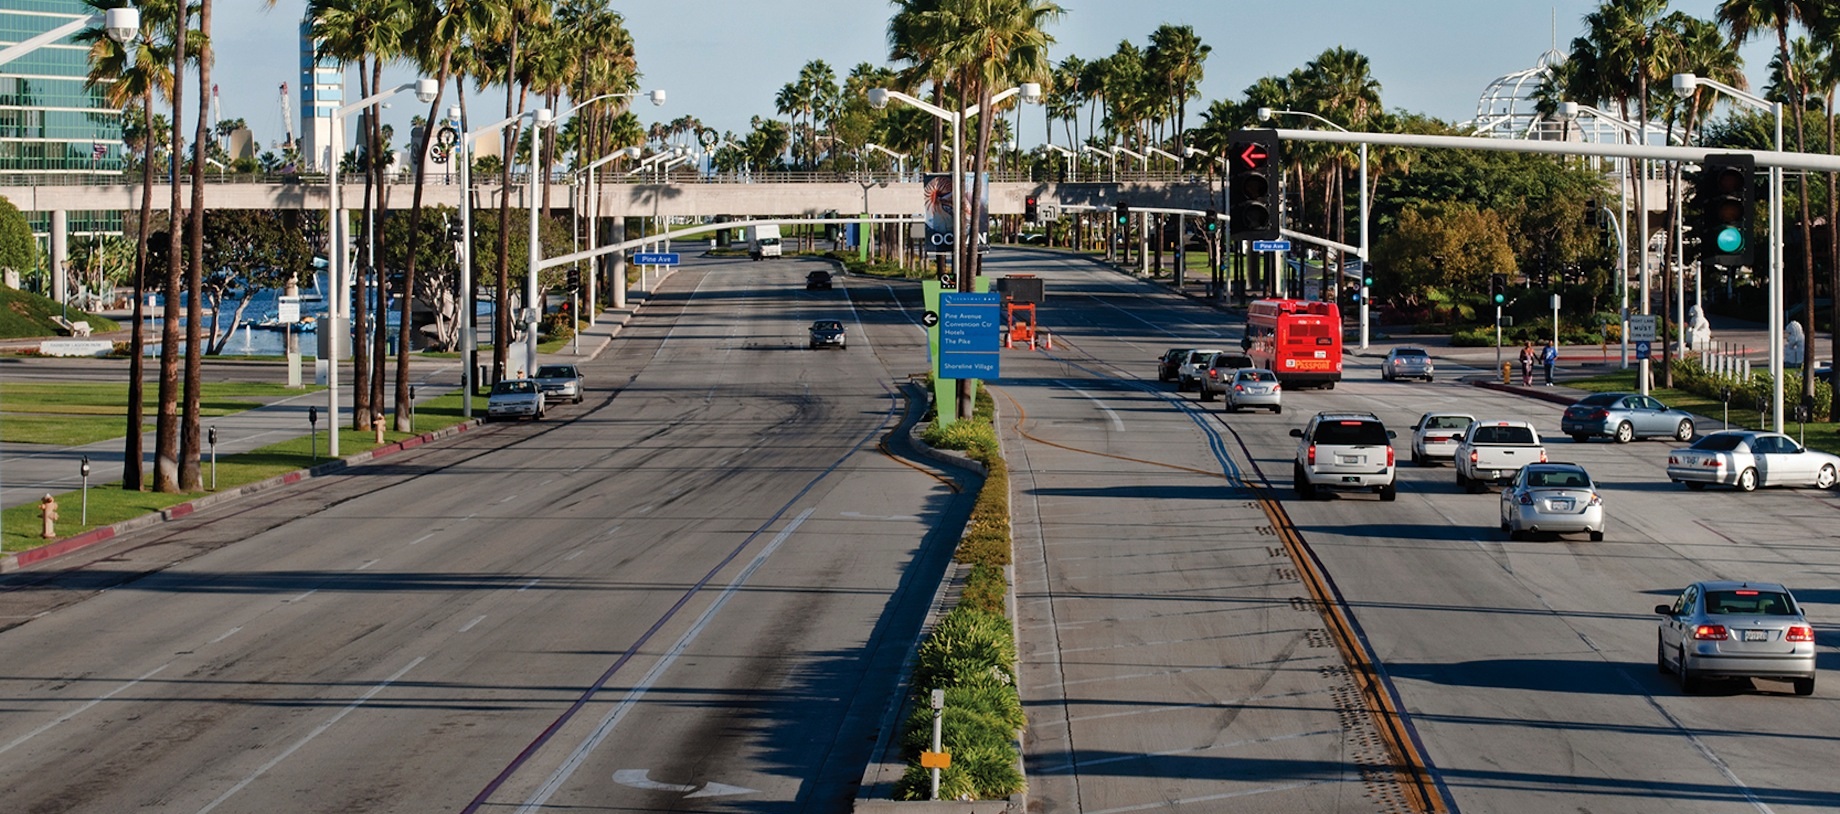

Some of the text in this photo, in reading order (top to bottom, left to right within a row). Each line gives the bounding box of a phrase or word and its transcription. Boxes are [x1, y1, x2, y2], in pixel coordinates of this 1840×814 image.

[931, 232, 987, 245] OCN
[974, 363, 994, 371] Village
[1295, 360, 1331, 370] PASSPORT
